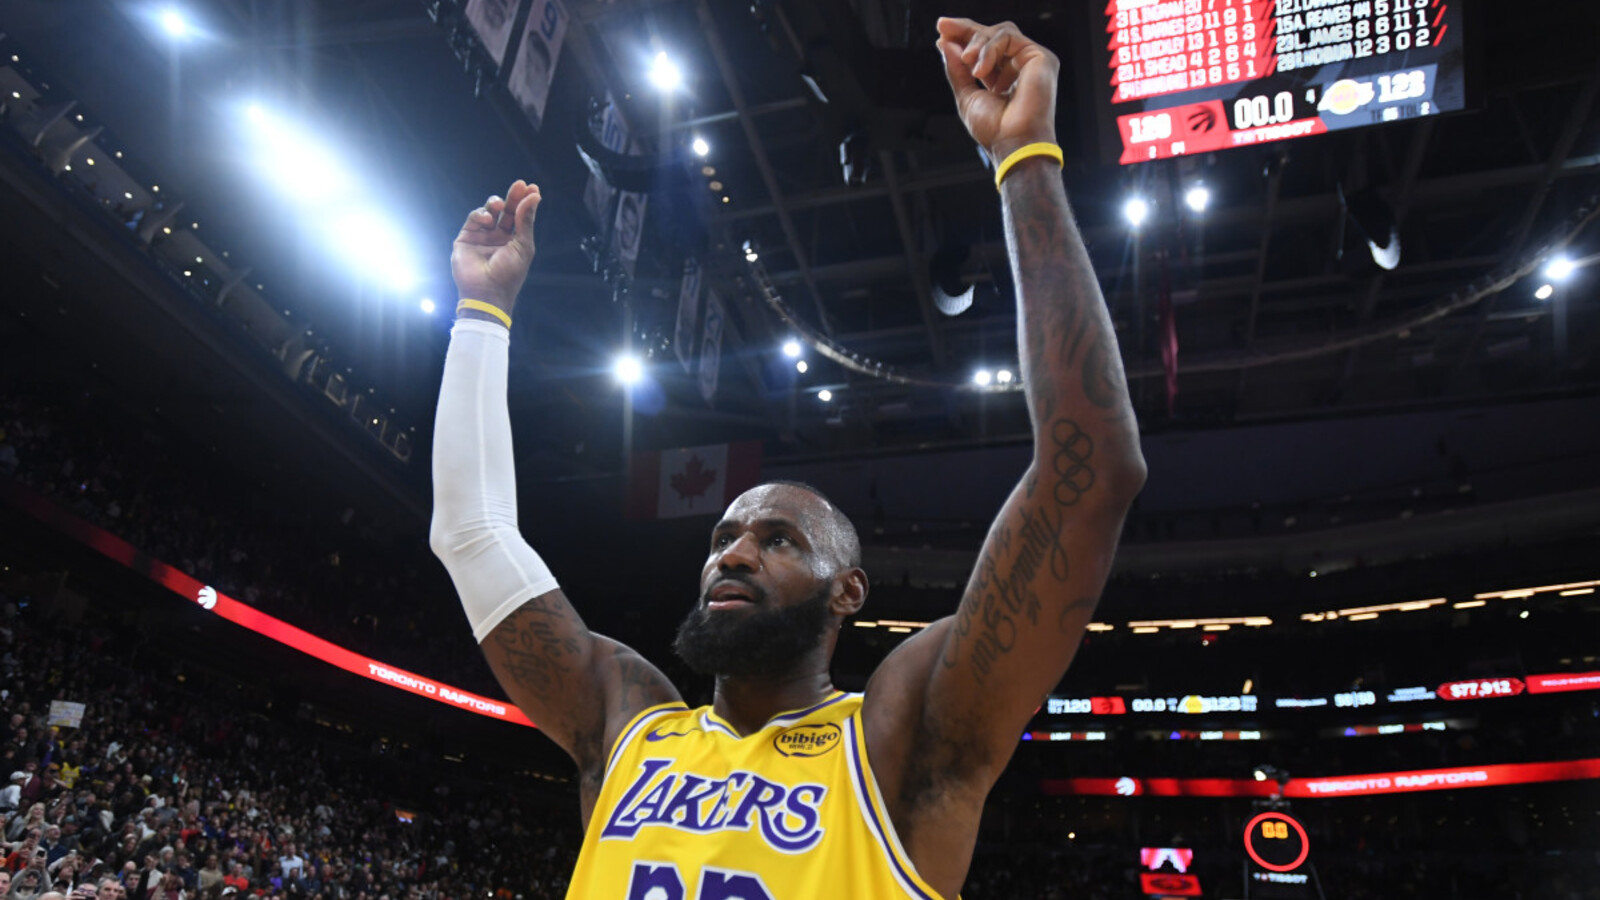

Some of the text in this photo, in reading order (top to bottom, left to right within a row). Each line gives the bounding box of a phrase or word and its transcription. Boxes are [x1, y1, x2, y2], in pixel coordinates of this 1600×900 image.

[1117, 29, 1129, 45] 4
[1243, 5, 1253, 22] 1
[1208, 30, 1219, 47] 1
[1242, 23, 1256, 40] 3
[1355, 19, 1370, 38] 8
[1375, 16, 1390, 35] 6
[1393, 12, 1412, 32] 11
[1416, 9, 1428, 27] 1
[1190, 52, 1203, 68] 4
[1208, 48, 1220, 66] 2
[1243, 41, 1256, 58] 4
[1354, 38, 1372, 58] 12
[1375, 35, 1390, 54] 3
[1395, 32, 1410, 51] 0
[1415, 28, 1430, 47] 2
[1246, 60, 1256, 77] 1
[1234, 91, 1293, 129] 00.0
[368, 663, 506, 716] TORONTO RAPTORS
[781, 732, 838, 747] bibigo
[1307, 771, 1488, 793] TORONTO RAPTORS
[599, 758, 829, 855] LAKERS
